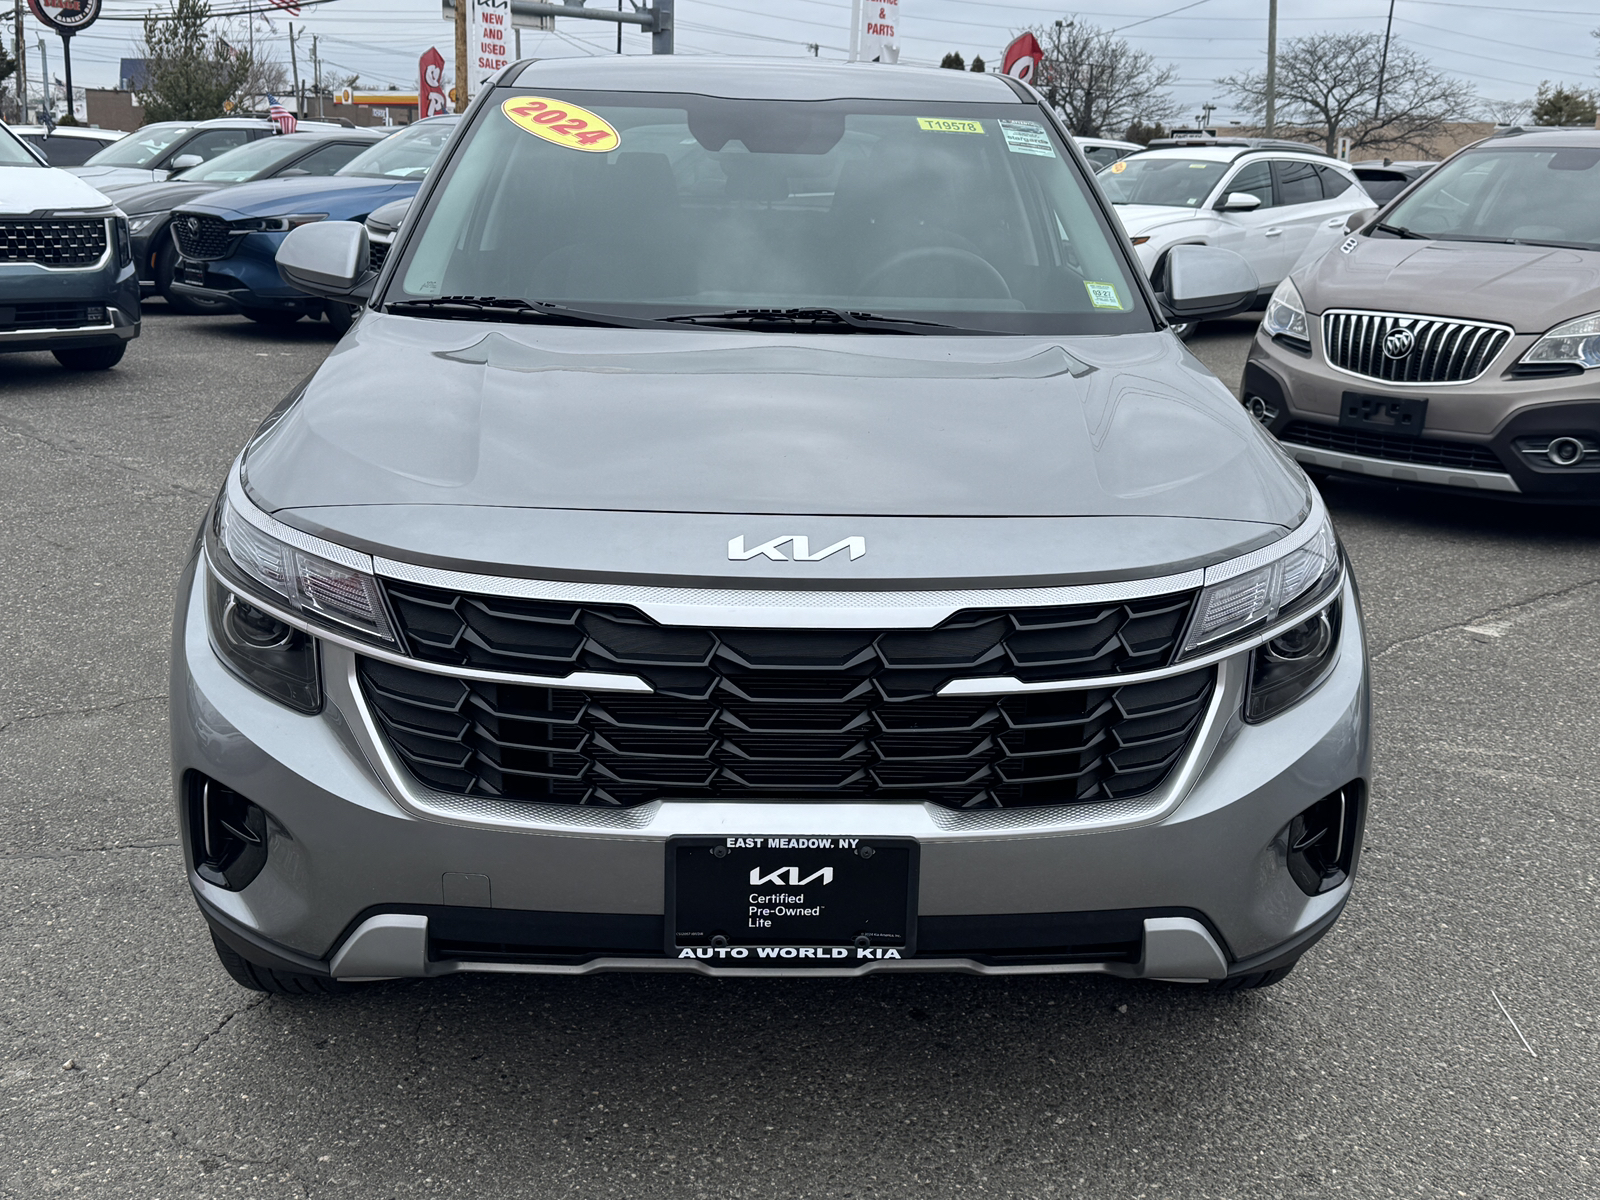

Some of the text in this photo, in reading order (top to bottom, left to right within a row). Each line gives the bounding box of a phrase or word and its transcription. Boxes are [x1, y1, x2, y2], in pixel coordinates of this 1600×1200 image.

[482, 12, 504, 25] NEW
[879, 7, 887, 19] &
[483, 28, 503, 40] AND
[867, 22, 895, 37] PARTS
[481, 42, 506, 56] USED
[478, 57, 508, 70] SALES
[508, 101, 613, 146] 2024
[924, 120, 977, 132] T19578
[728, 534, 866, 562] KIA
[726, 837, 764, 848] EAST
[838, 838, 860, 849] NY
[749, 866, 834, 886] KIA
[749, 893, 804, 904] Certified
[748, 917, 772, 928] Lite
[678, 947, 901, 959] AUTO WORLD KIA
